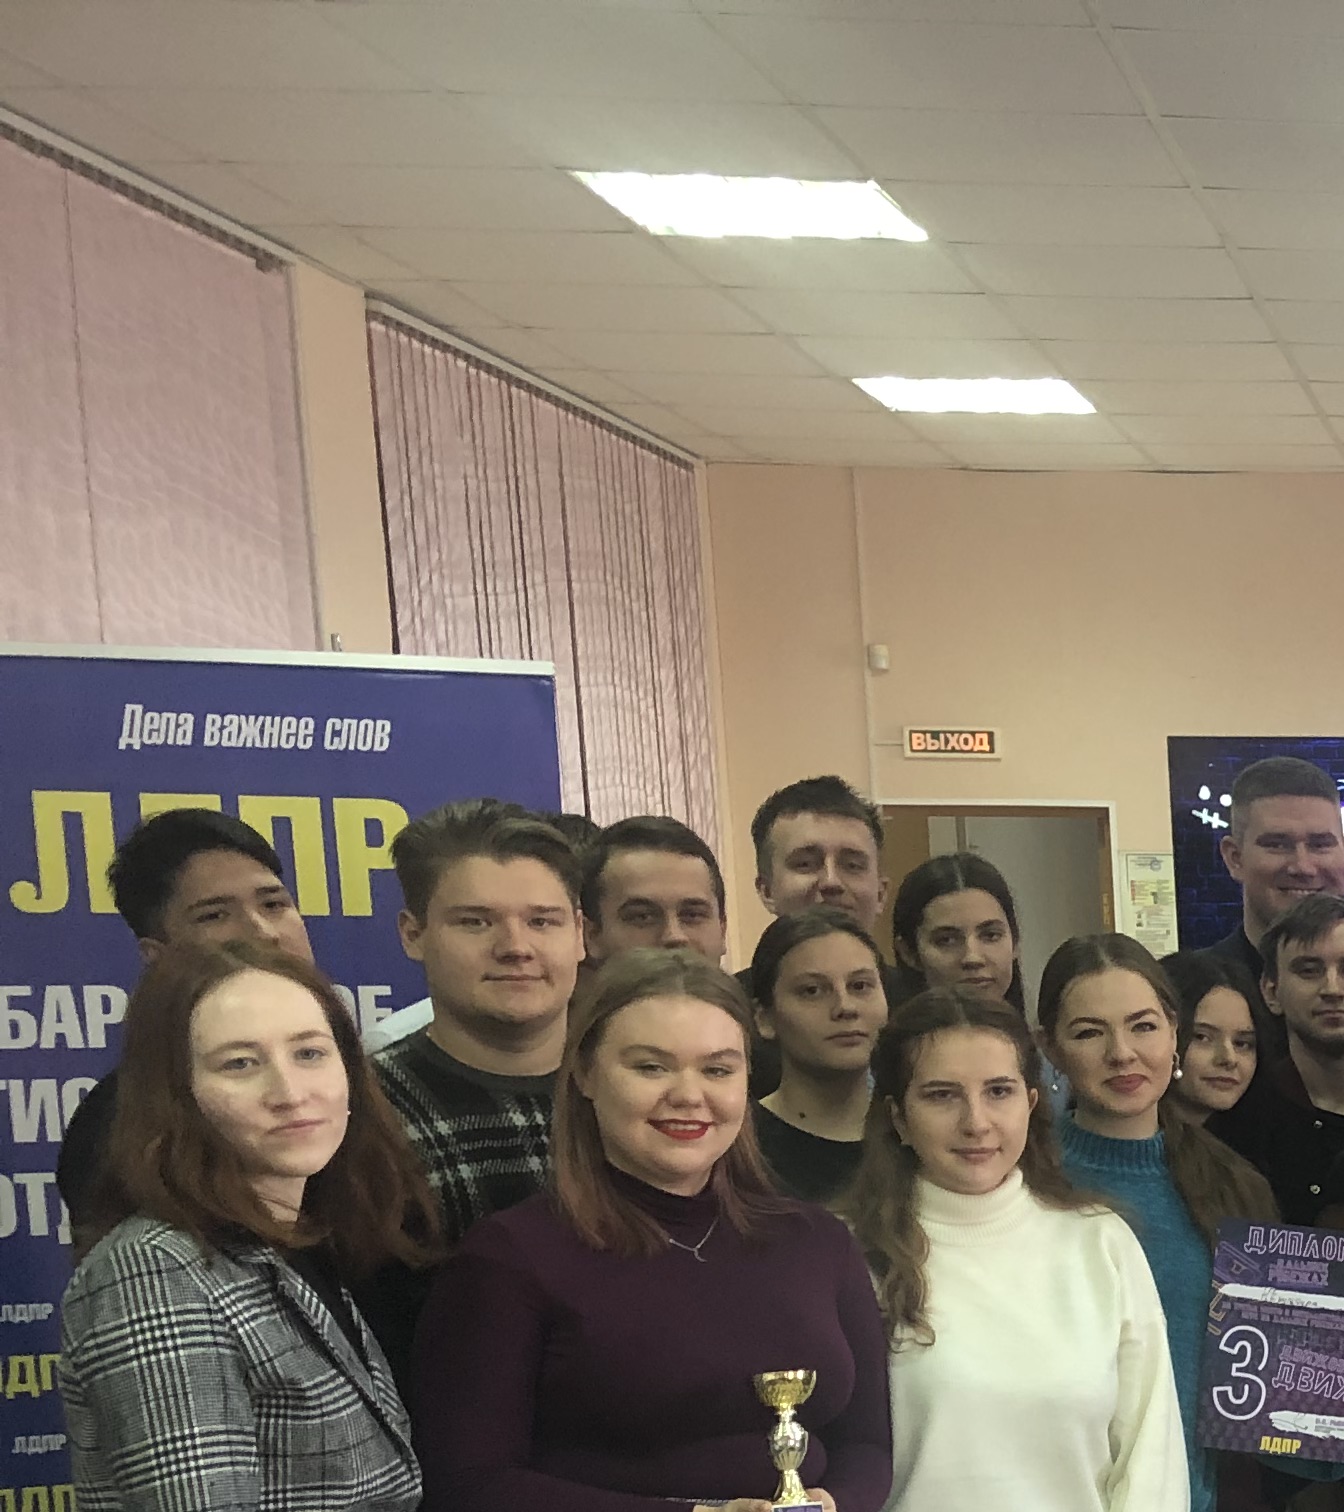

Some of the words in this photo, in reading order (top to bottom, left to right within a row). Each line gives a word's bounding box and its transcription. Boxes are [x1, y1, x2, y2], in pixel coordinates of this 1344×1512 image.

[118, 703, 194, 750] Дела
[203, 712, 314, 749] важнее
[323, 717, 391, 752] слов
[911, 732, 990, 752] ВЫХОД
[9, 791, 410, 917] ЛПР
[1212, 1325, 1269, 1420] 3
[11, 1434, 67, 1455] ЛДПР
[1260, 1435, 1301, 1454] ЛДПР
